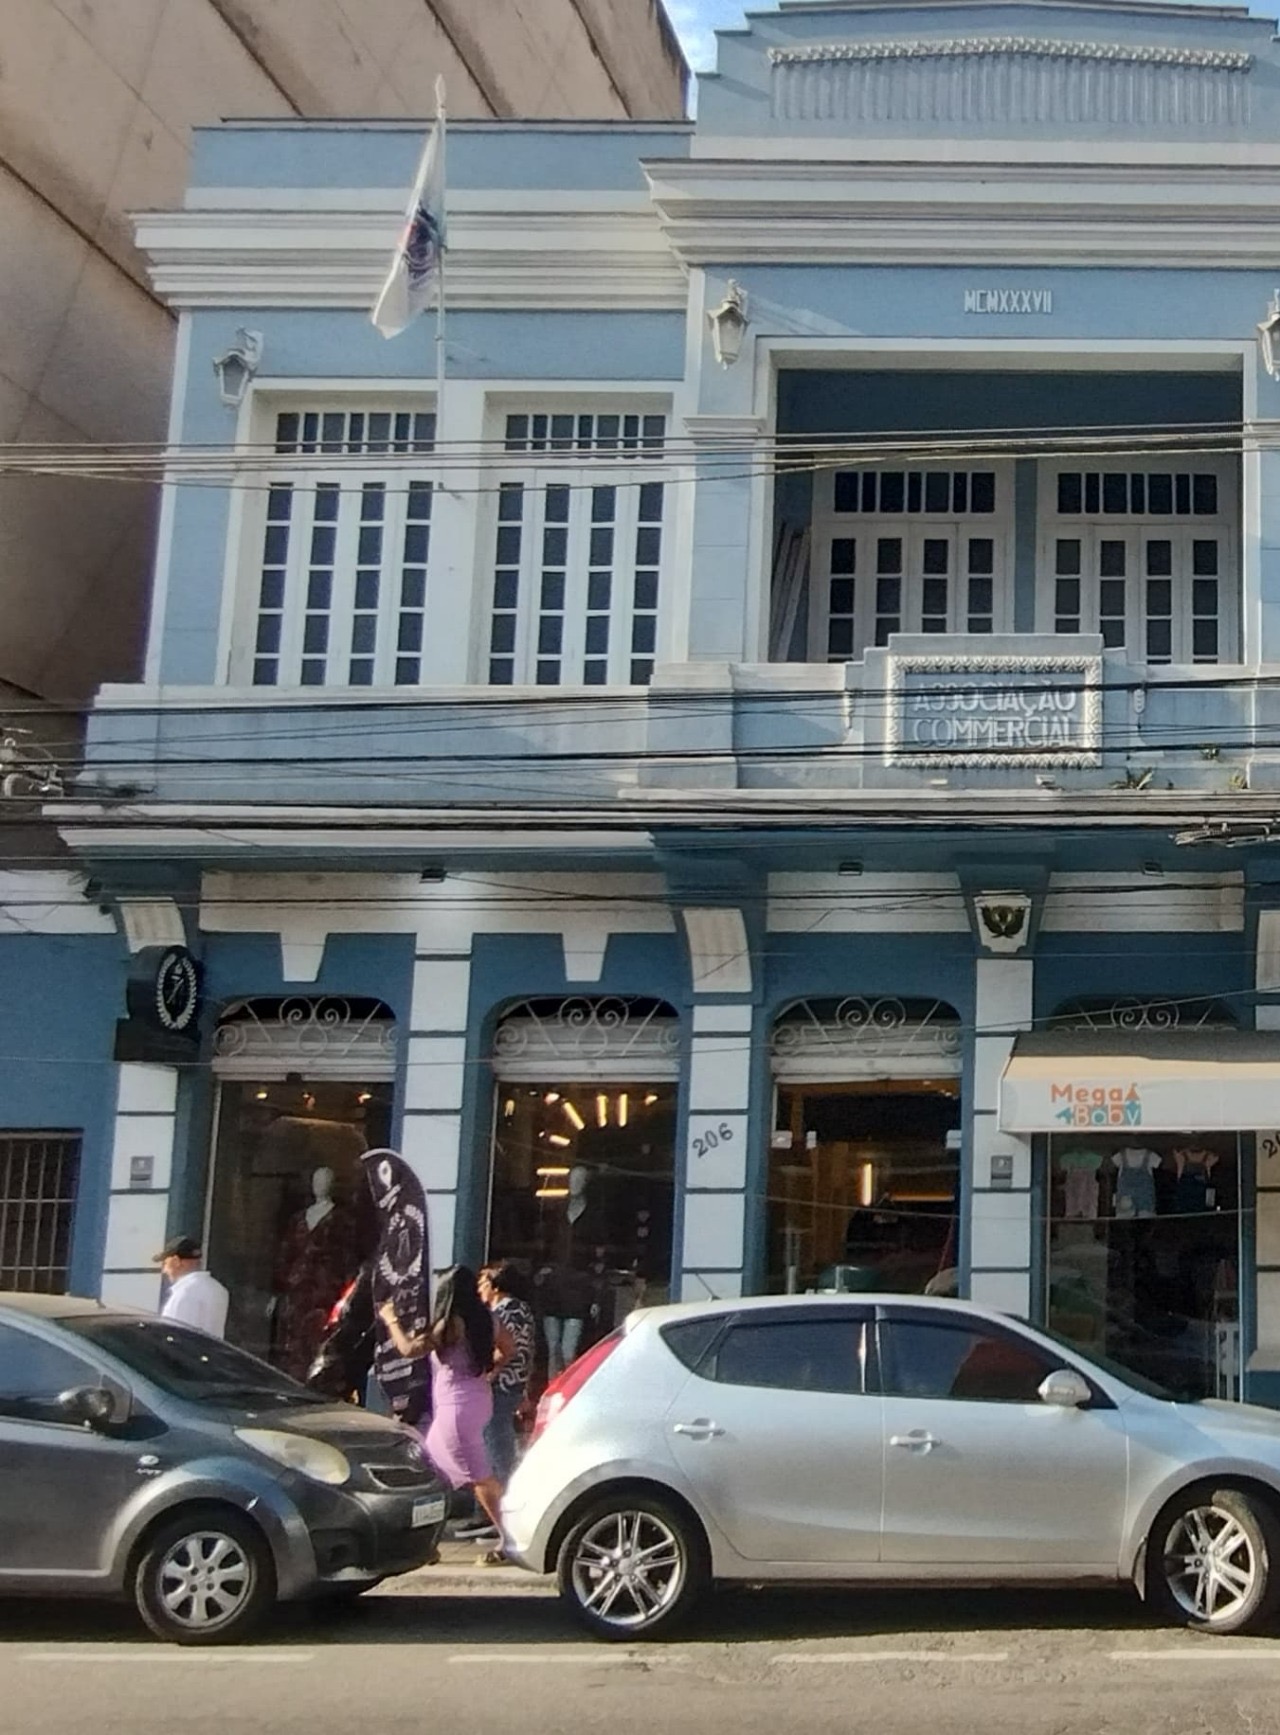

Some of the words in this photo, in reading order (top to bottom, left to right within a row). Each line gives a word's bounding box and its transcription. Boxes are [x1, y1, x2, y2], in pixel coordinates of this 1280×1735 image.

[964, 289, 1052, 313] MCMXXXVII
[912, 716, 1077, 748] COMMERCIAL
[1051, 1083, 1123, 1107] Mega
[1074, 1104, 1141, 1126] Baby
[692, 1122, 733, 1159] 206
